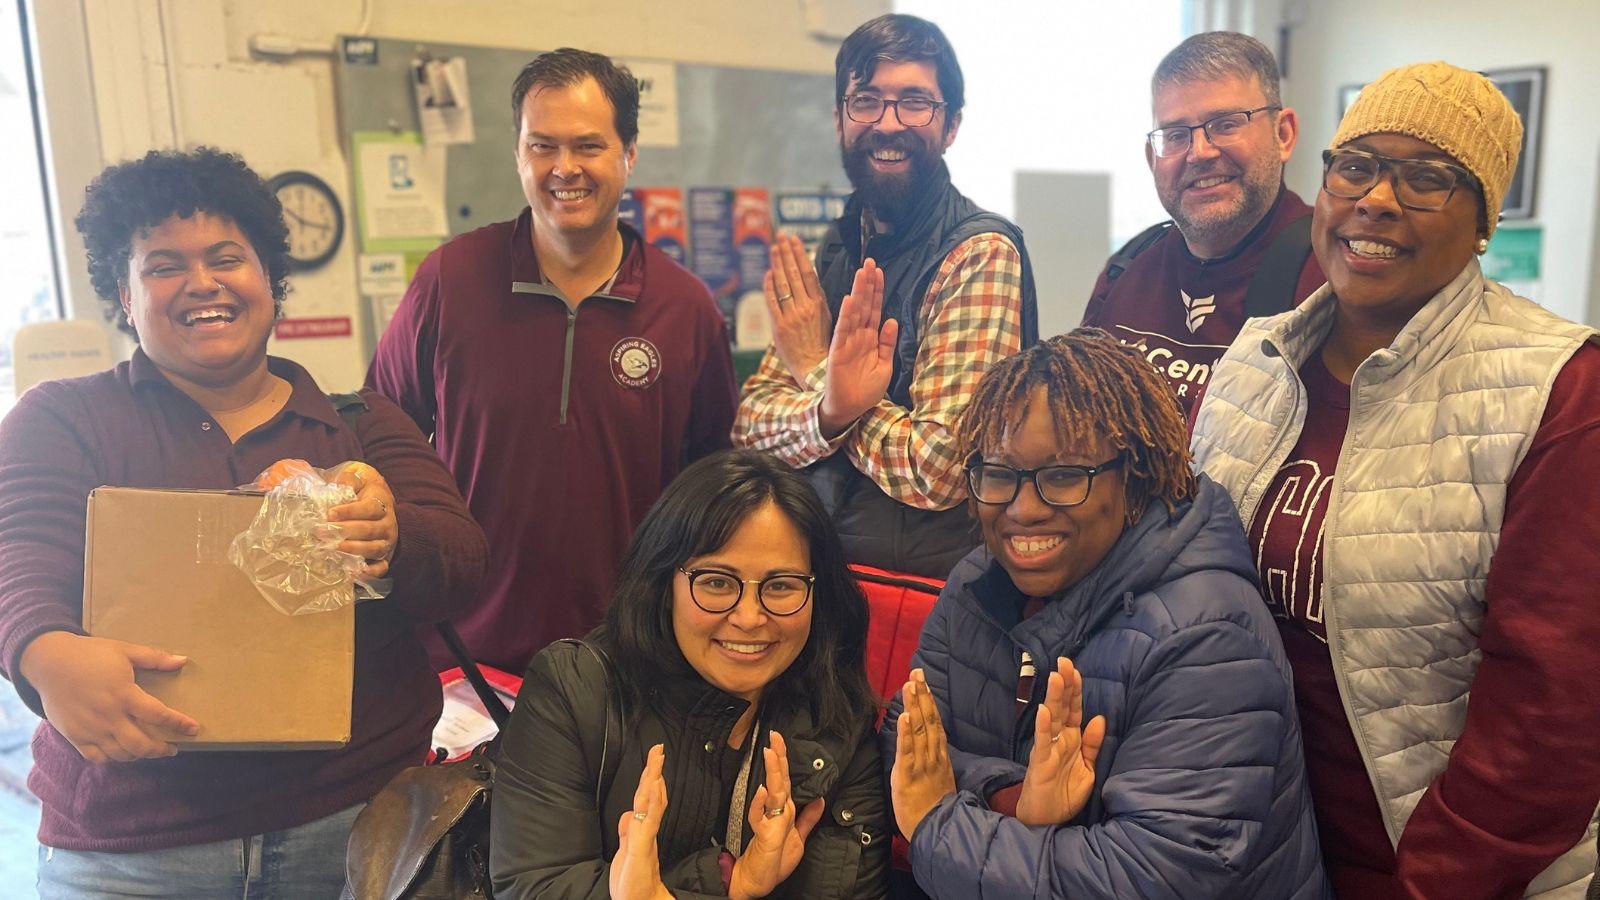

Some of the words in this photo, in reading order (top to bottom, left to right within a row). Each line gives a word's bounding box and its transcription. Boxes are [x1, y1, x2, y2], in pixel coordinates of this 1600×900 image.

[613, 341, 640, 363] ASPIRING
[640, 342, 657, 368] EAGLES
[618, 374, 649, 387] ACADEMY
